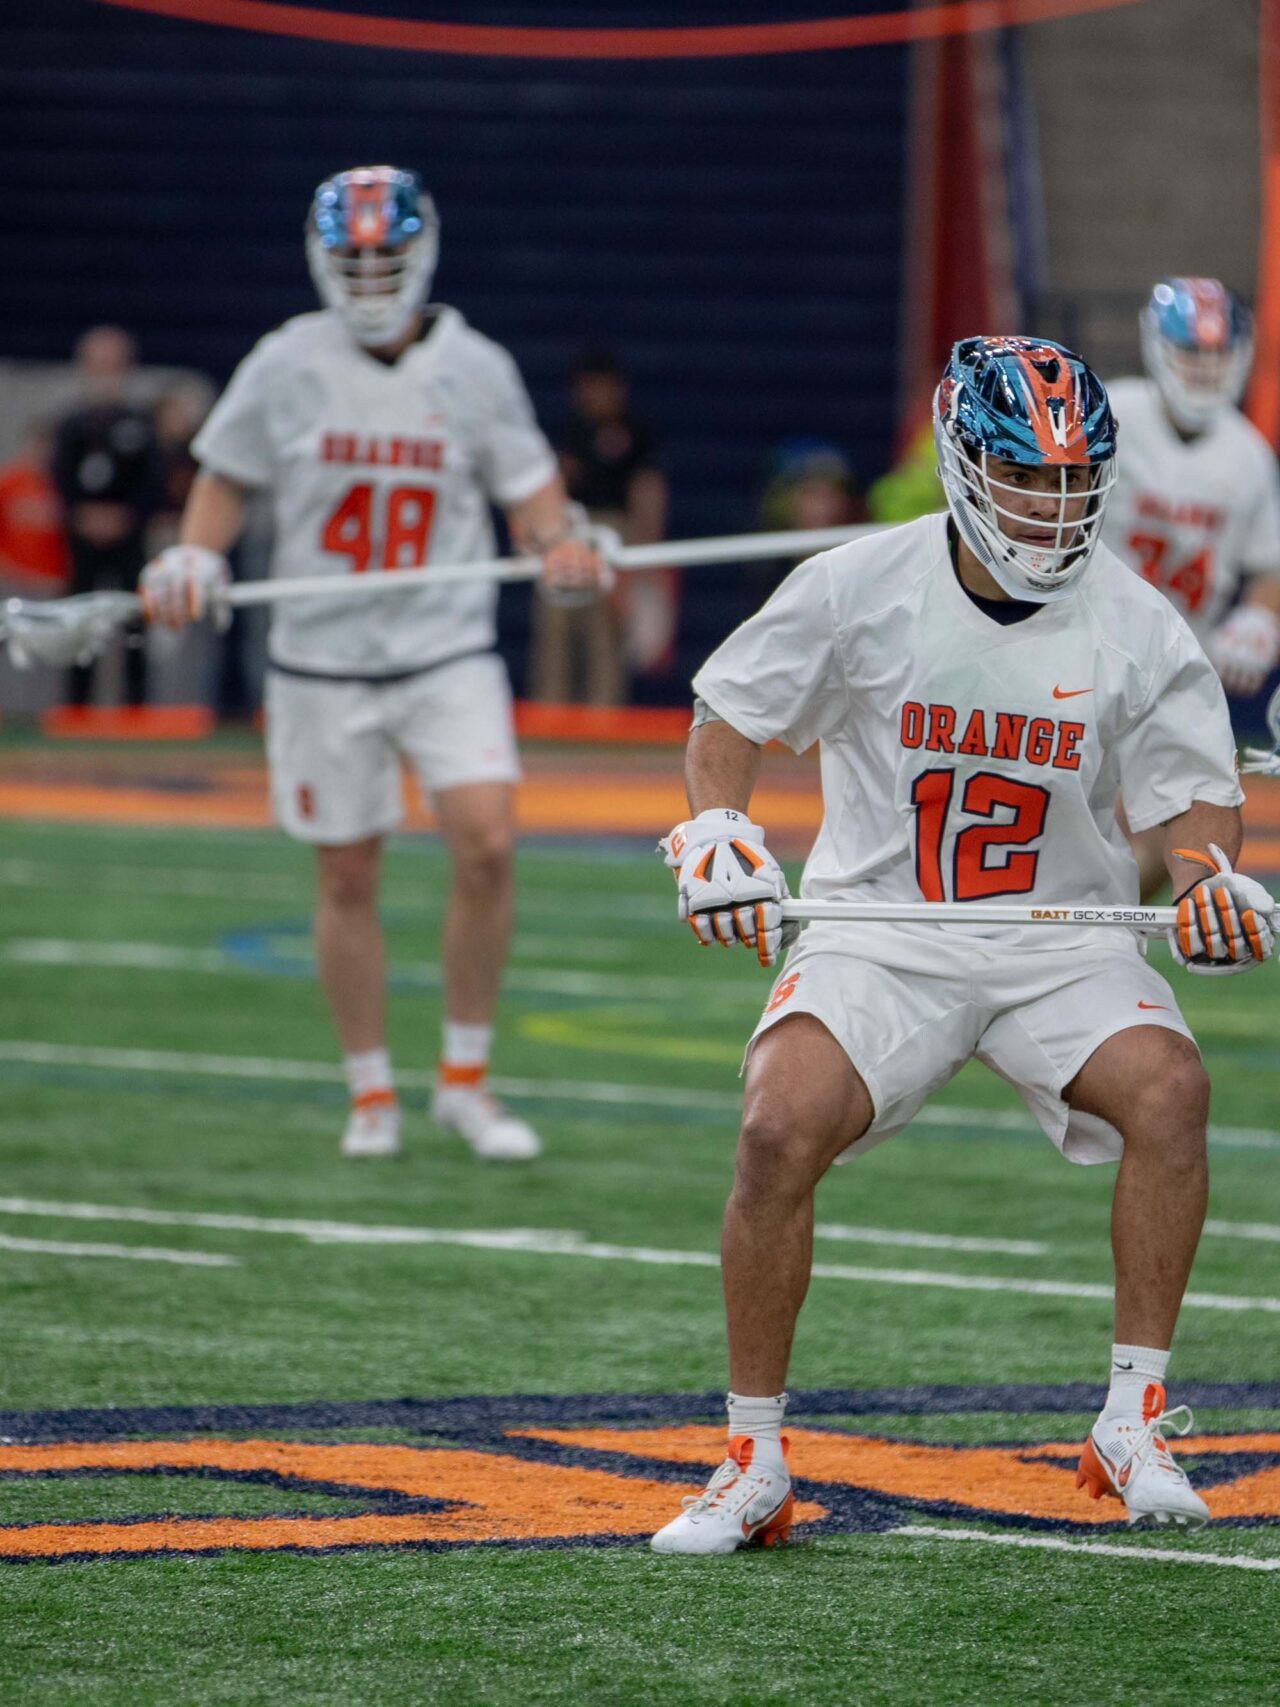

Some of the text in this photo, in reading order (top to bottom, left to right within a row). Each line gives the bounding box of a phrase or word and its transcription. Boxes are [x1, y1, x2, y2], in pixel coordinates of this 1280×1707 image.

[321, 480, 436, 572] 48
[900, 701, 1086, 771] ORANGE
[725, 810, 739, 821] 12
[910, 768, 1051, 903] 12
[1031, 910, 1070, 920] GAIT
